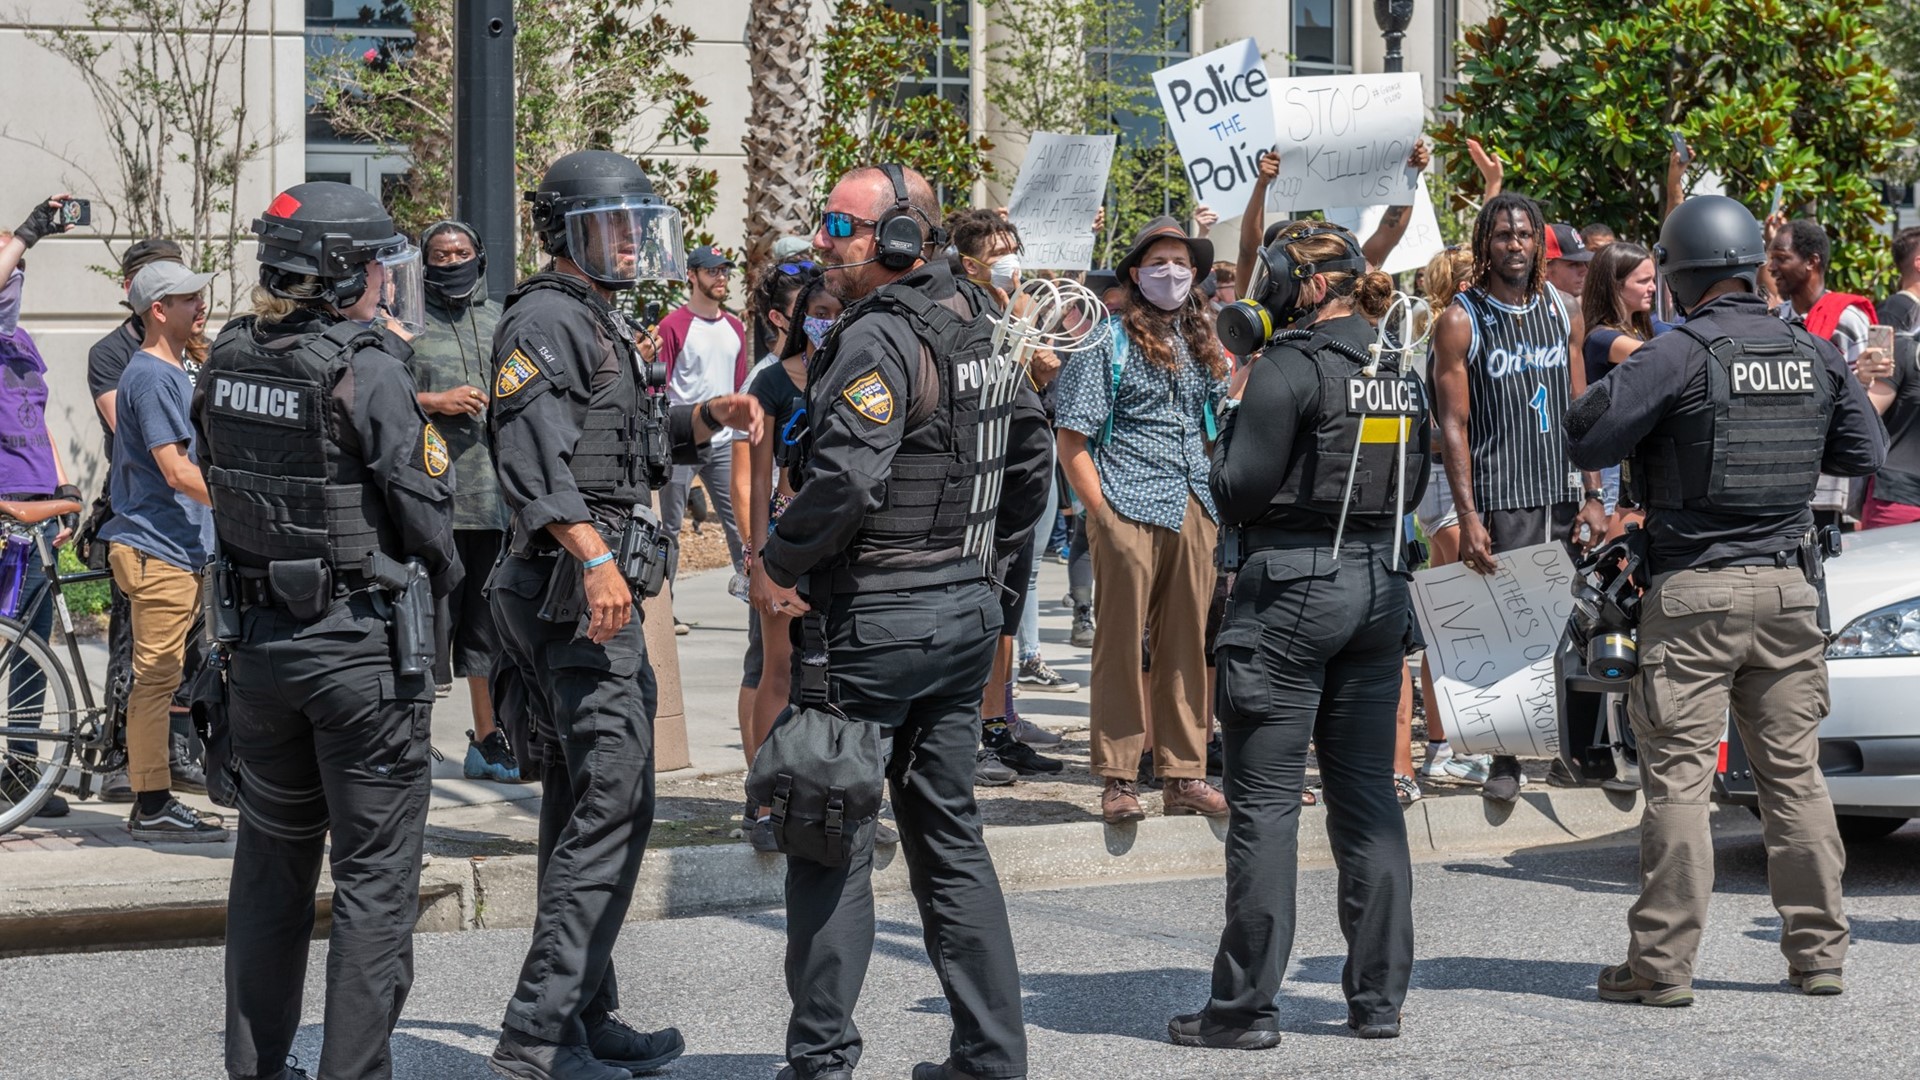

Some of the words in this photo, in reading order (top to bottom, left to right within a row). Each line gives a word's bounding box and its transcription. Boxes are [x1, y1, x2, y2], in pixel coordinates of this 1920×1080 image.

[1168, 64, 1268, 123] Police
[1285, 84, 1370, 142] STOP
[1209, 114, 1246, 141] THE
[1031, 144, 1059, 170] AN
[1188, 142, 1276, 200] Polic
[1306, 140, 1403, 182] KILLING
[1024, 173, 1072, 192] AGAINST
[1073, 174, 1100, 193] ONE
[1016, 197, 1029, 217] IS
[1031, 198, 1050, 217] AN
[1050, 197, 1097, 217] ATTACK
[1058, 218, 1072, 234] US
[539, 345, 556, 363] 1341
[1350, 379, 1419, 411] POLICE
[1733, 361, 1814, 391] POLICE
[214, 378, 299, 420] POLICE
[1528, 382, 1549, 433] 1
[1532, 549, 1569, 593] OUR
[1425, 574, 1496, 682] LIVES
[1494, 555, 1539, 637] FATHERS
[1523, 644, 1555, 691] OUR
